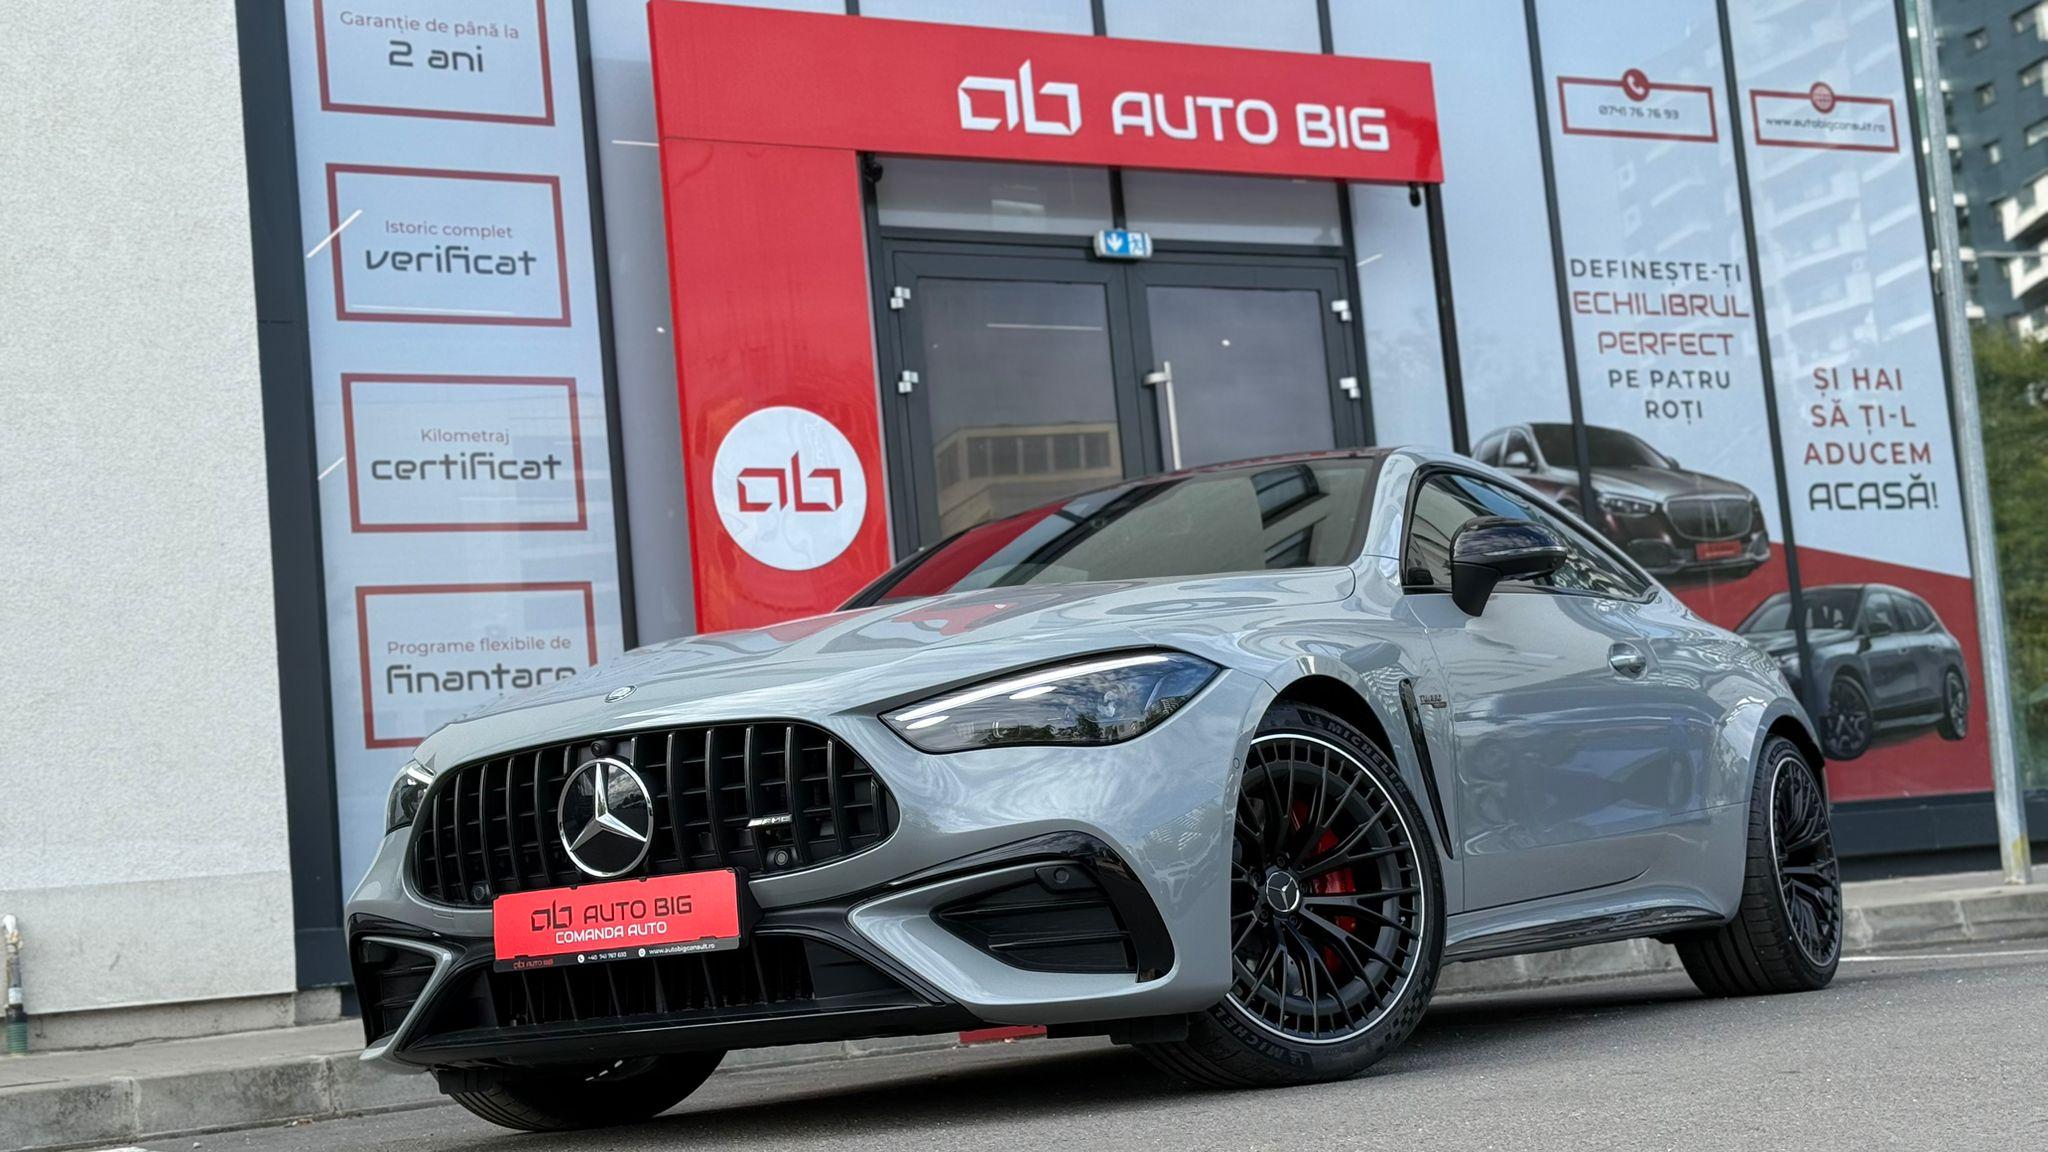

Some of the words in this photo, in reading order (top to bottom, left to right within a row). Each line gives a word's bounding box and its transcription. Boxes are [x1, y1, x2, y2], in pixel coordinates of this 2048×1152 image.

[340, 11, 420, 33] Garanție
[426, 19, 449, 33] de
[454, 21, 499, 38] până
[504, 24, 520, 39] la
[388, 40, 414, 67] 2
[427, 45, 484, 72] ani
[1112, 92, 1279, 144] AUTO
[1296, 103, 1389, 150] BIG
[385, 220, 438, 235] Istoric
[442, 223, 513, 240] complet
[365, 245, 537, 276] verificat
[1573, 291, 1750, 317] ECHILIBRUL
[1598, 332, 1735, 356] PERFECT
[1609, 370, 1640, 389] PE
[1650, 370, 1731, 390] PATRU
[1813, 367, 1839, 398] ȘI
[1852, 368, 1903, 391] HAI
[1645, 400, 1703, 426] ROȚI
[1810, 400, 1848, 428] SĂ
[1859, 404, 1917, 435] ȚI-L
[421, 429, 510, 446] Kilometraj
[371, 452, 562, 481] certificat
[1804, 442, 1932, 465] ADUCEM
[1809, 474, 1939, 511] ACASĂ!
[387, 639, 475, 657] Programe
[480, 636, 546, 651] flexibile
[550, 636, 572, 650] de
[583, 899, 647, 925] AUTO
[654, 895, 692, 917] BIG
[555, 927, 624, 944] COMANDA
[627, 921, 667, 935] AUTO
